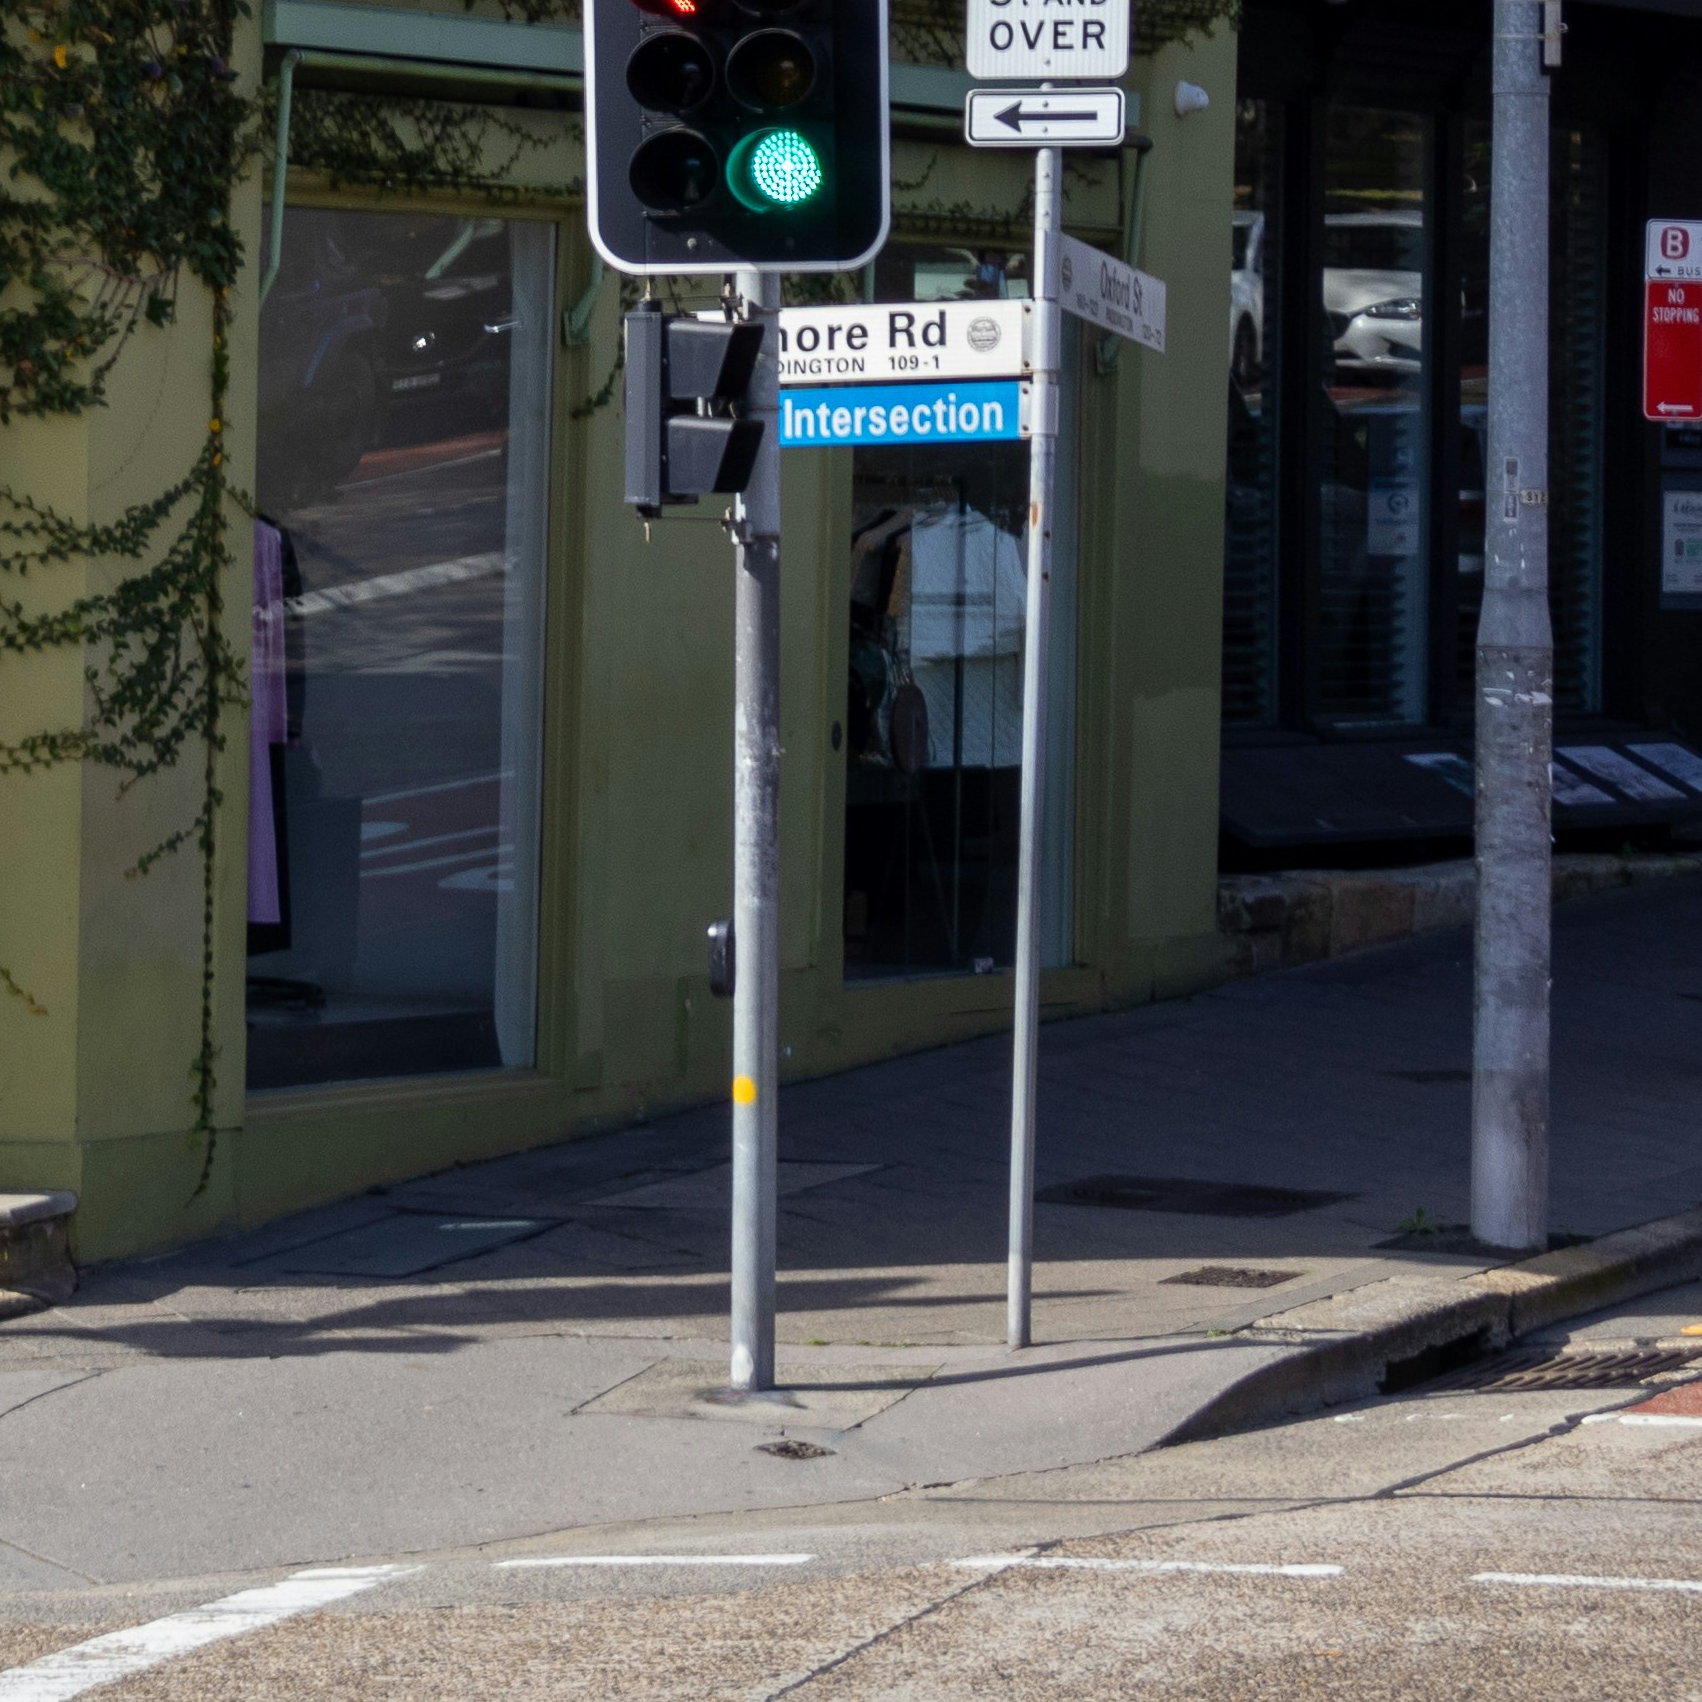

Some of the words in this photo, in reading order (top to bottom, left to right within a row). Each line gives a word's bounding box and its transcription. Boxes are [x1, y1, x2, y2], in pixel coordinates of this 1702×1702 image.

[989, 19, 1107, 51] OVER
[1667, 288, 1685, 304] NO
[888, 309, 947, 349] Rd
[1652, 306, 1701, 324] STOPPING
[783, 392, 1004, 440] Intersection
